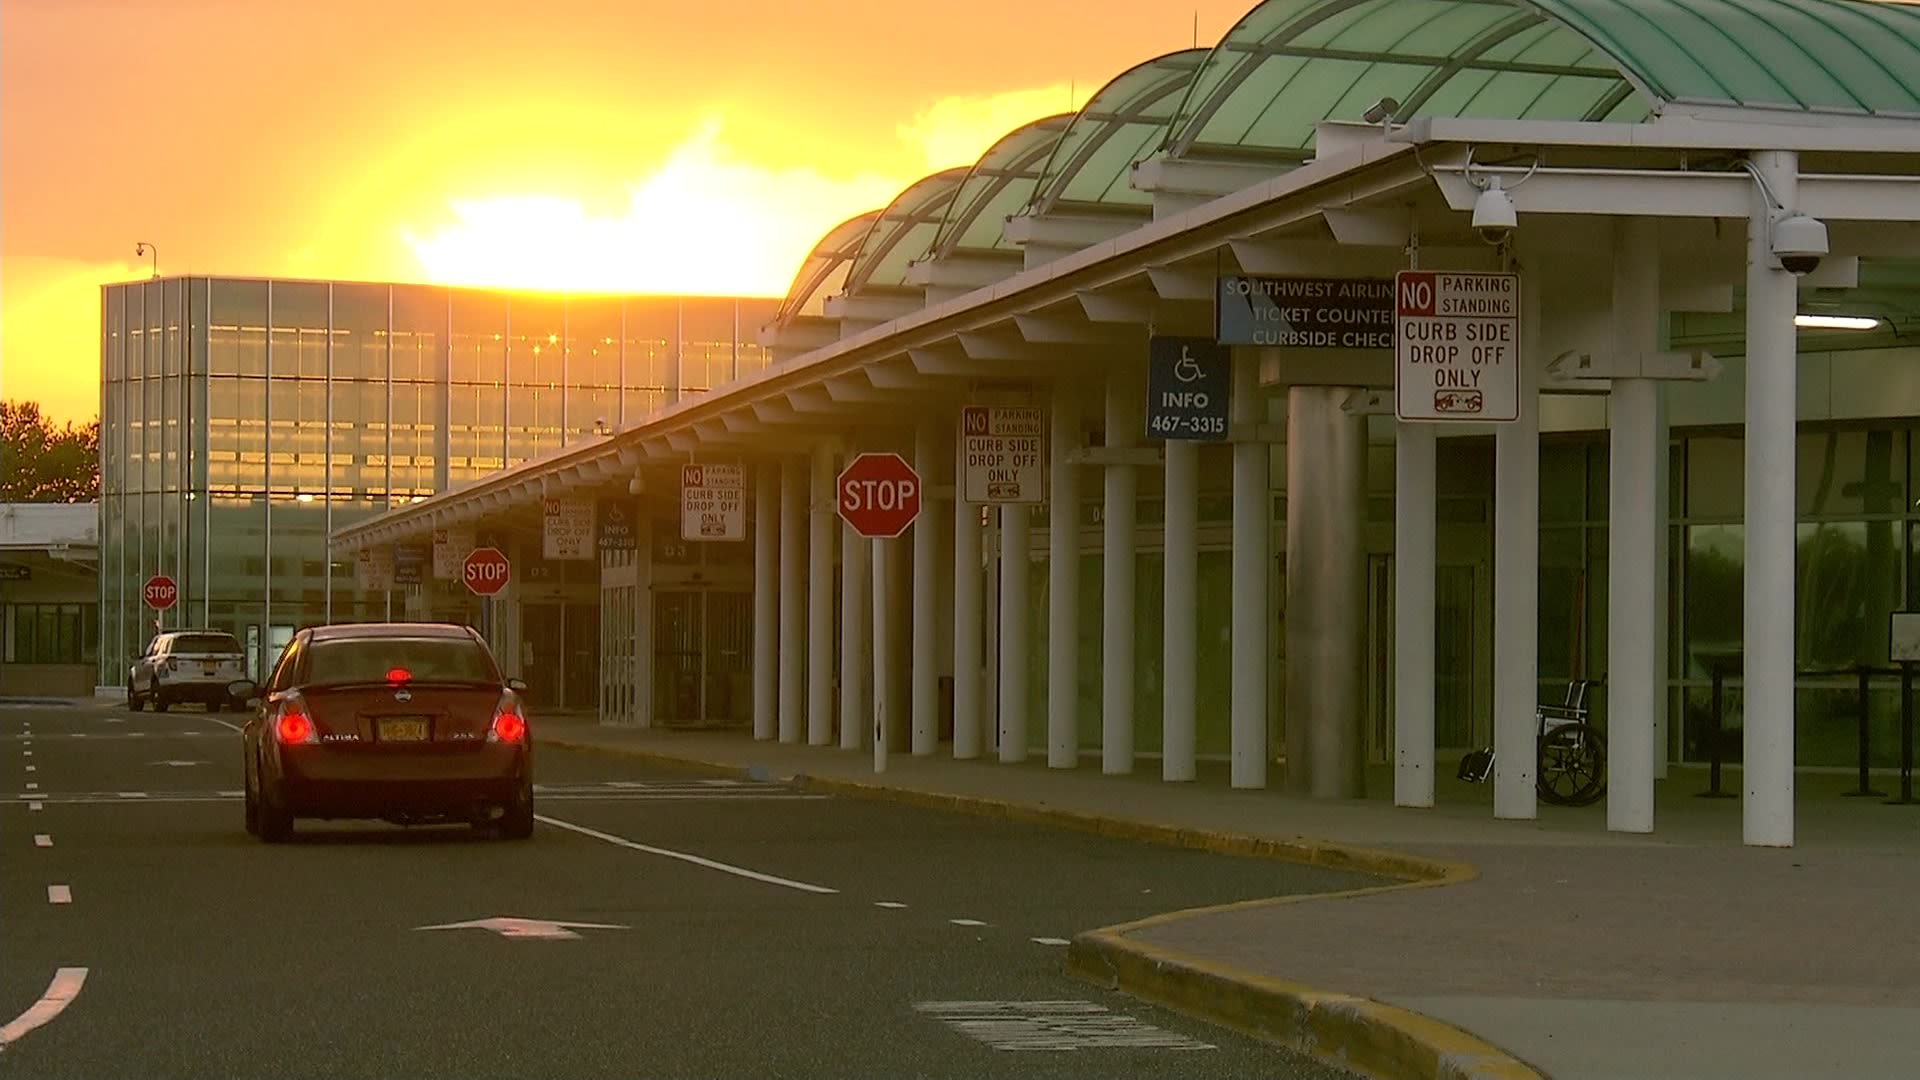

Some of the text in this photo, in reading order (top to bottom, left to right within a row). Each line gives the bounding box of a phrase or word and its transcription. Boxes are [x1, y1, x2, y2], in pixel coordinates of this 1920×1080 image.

[1226, 281, 1334, 298] SOUTHWEST
[1443, 277, 1511, 293] PARKING
[1402, 281, 1431, 310] NO
[1442, 299, 1511, 313] STANDING
[1252, 307, 1312, 323] TICKET
[1252, 330, 1337, 346] CURBSIDE
[1405, 322, 1511, 342] CURB SIDE
[1410, 345, 1505, 365] DROP OFF
[1435, 368, 1481, 387] ONLY
[1162, 392, 1209, 408] INFO
[967, 413, 986, 432] NO
[994, 410, 1040, 420] PARKING
[994, 424, 1040, 433] STANDING
[1152, 415, 1224, 433] 467-3315
[969, 439, 1037, 452] CURB SIDE
[969, 454, 1037, 467] DROP OFF
[686, 469, 701, 485] NO
[988, 469, 1018, 481] ONLY
[686, 490, 738, 500] CURB SIDE
[844, 480, 915, 511] STOP
[546, 501, 560, 515] NO
[686, 502, 738, 511] DROP OFF
[701, 513, 725, 523] ONLY
[604, 525, 629, 535] INFO
[557, 537, 582, 547] ONLY
[467, 563, 506, 581] STOP
[147, 586, 175, 599] STOP
